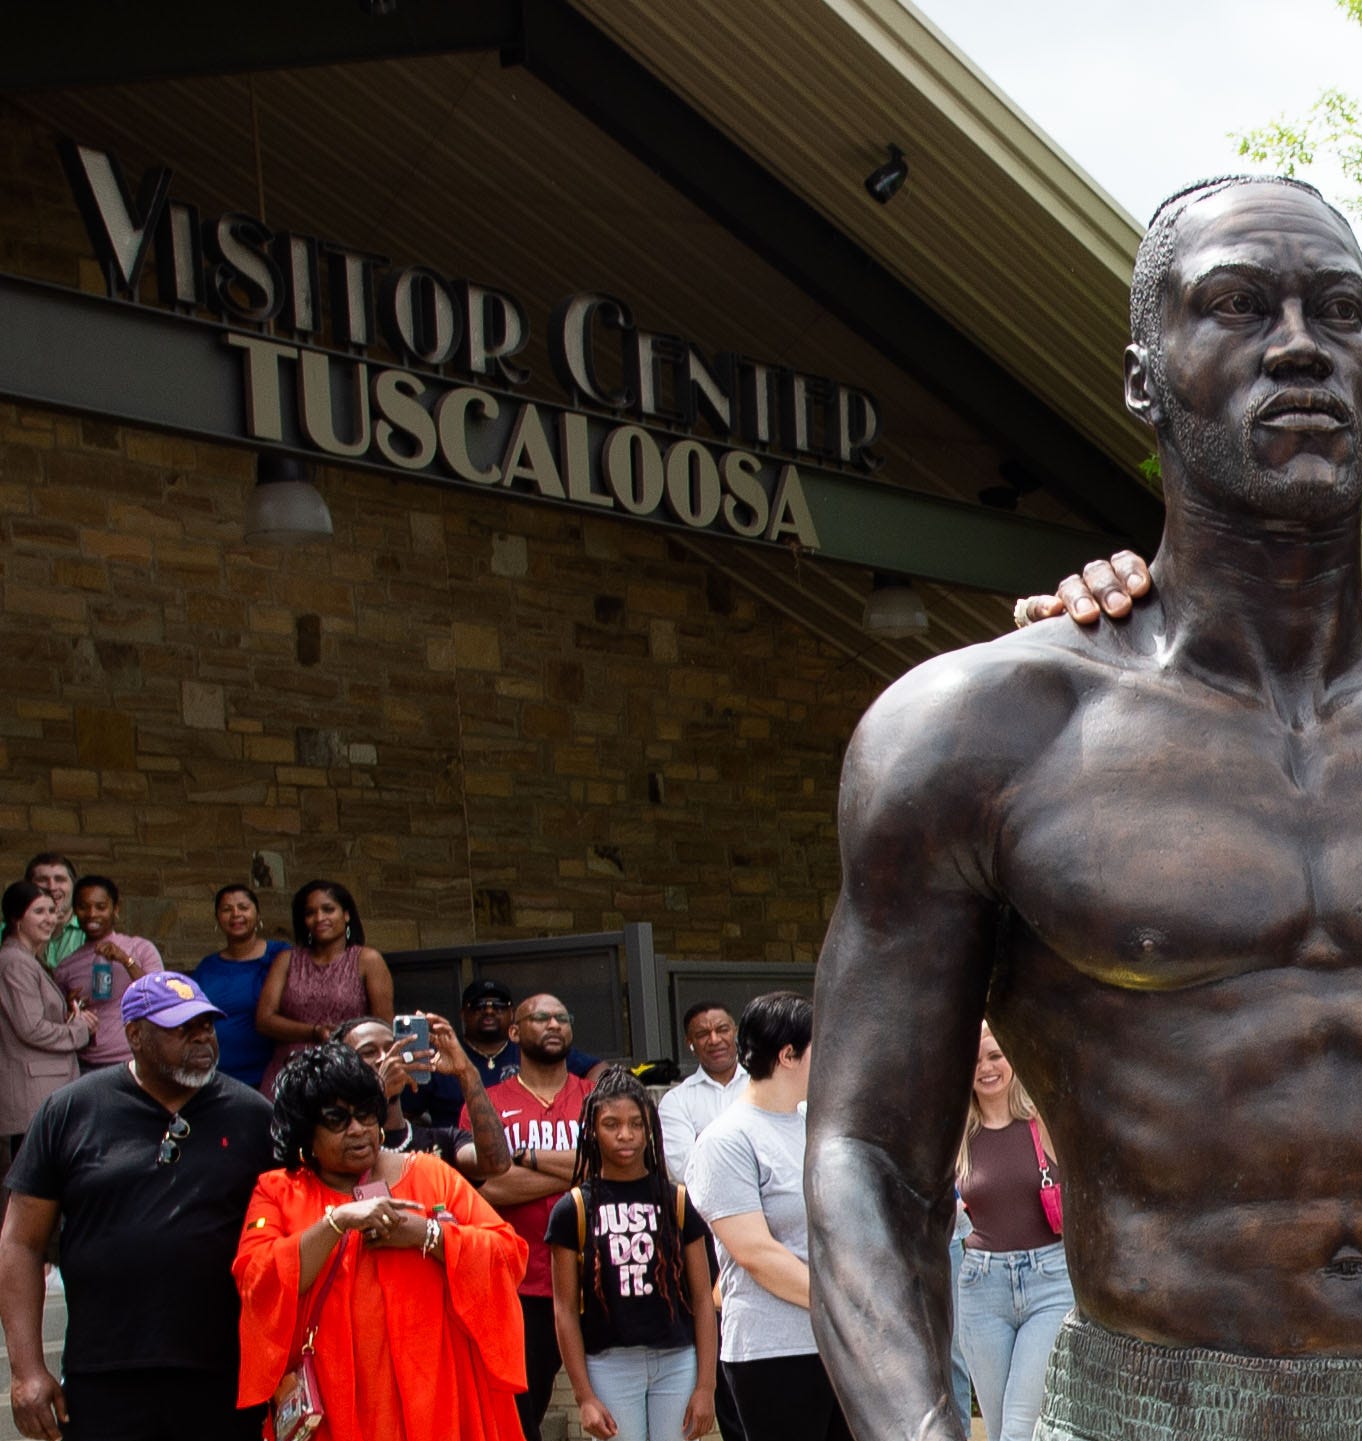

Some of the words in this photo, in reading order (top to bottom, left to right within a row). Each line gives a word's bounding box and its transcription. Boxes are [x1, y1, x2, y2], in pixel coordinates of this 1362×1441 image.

[61, 140, 531, 384] VISITOR
[549, 291, 886, 473] CENTER
[226, 332, 822, 551] TUSCALOOSA
[504, 1118, 586, 1157] LABA
[594, 1202, 661, 1237] JUST
[608, 1231, 656, 1266] DO
[619, 1264, 654, 1297] IT.
